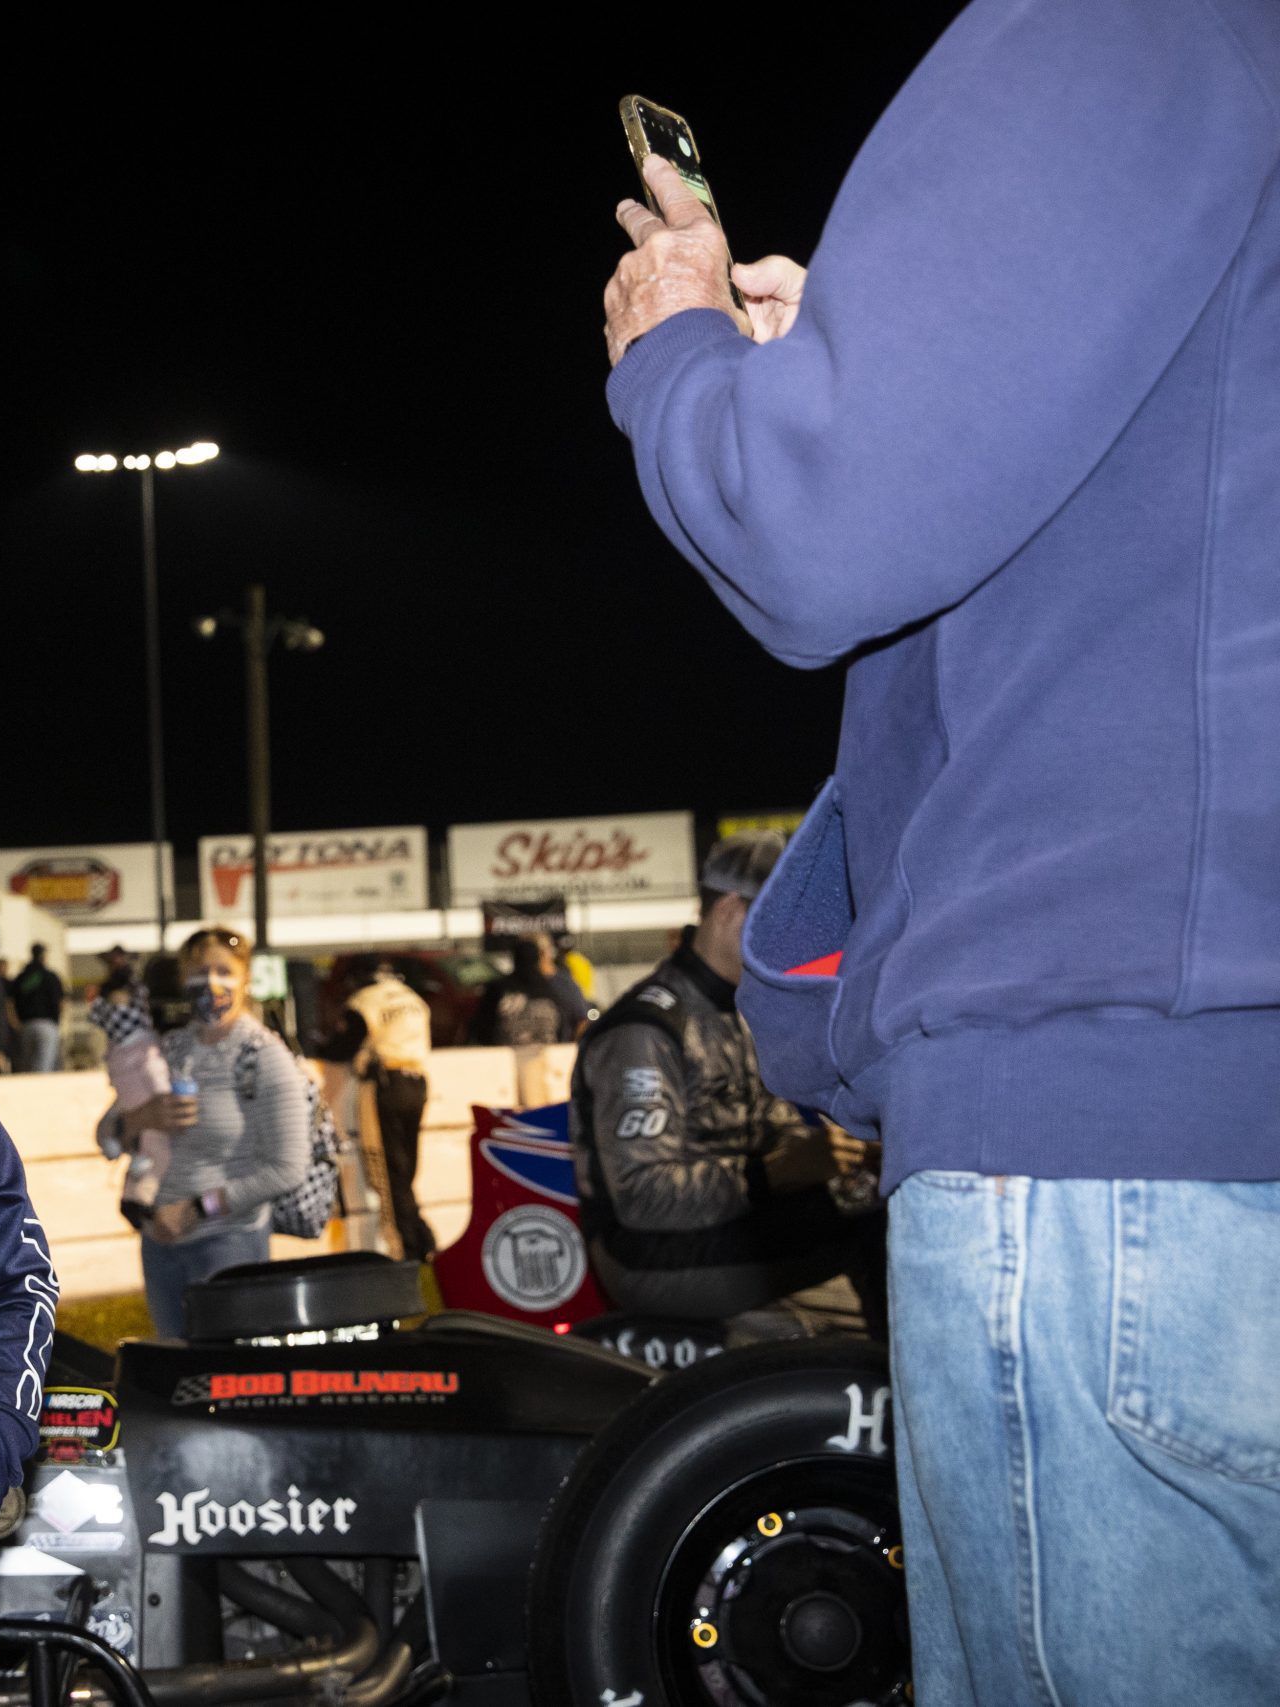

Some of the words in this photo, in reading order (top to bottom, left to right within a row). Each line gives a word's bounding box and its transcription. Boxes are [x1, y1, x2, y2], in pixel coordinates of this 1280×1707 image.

[616, 1108, 669, 1138] 60
[210, 1373, 285, 1399] BOB
[291, 1370, 459, 1396] BRUNEAU
[48, 1394, 104, 1409] NASCAR
[219, 1397, 310, 1409] ENGINE
[148, 1484, 357, 1546] Hoosier
